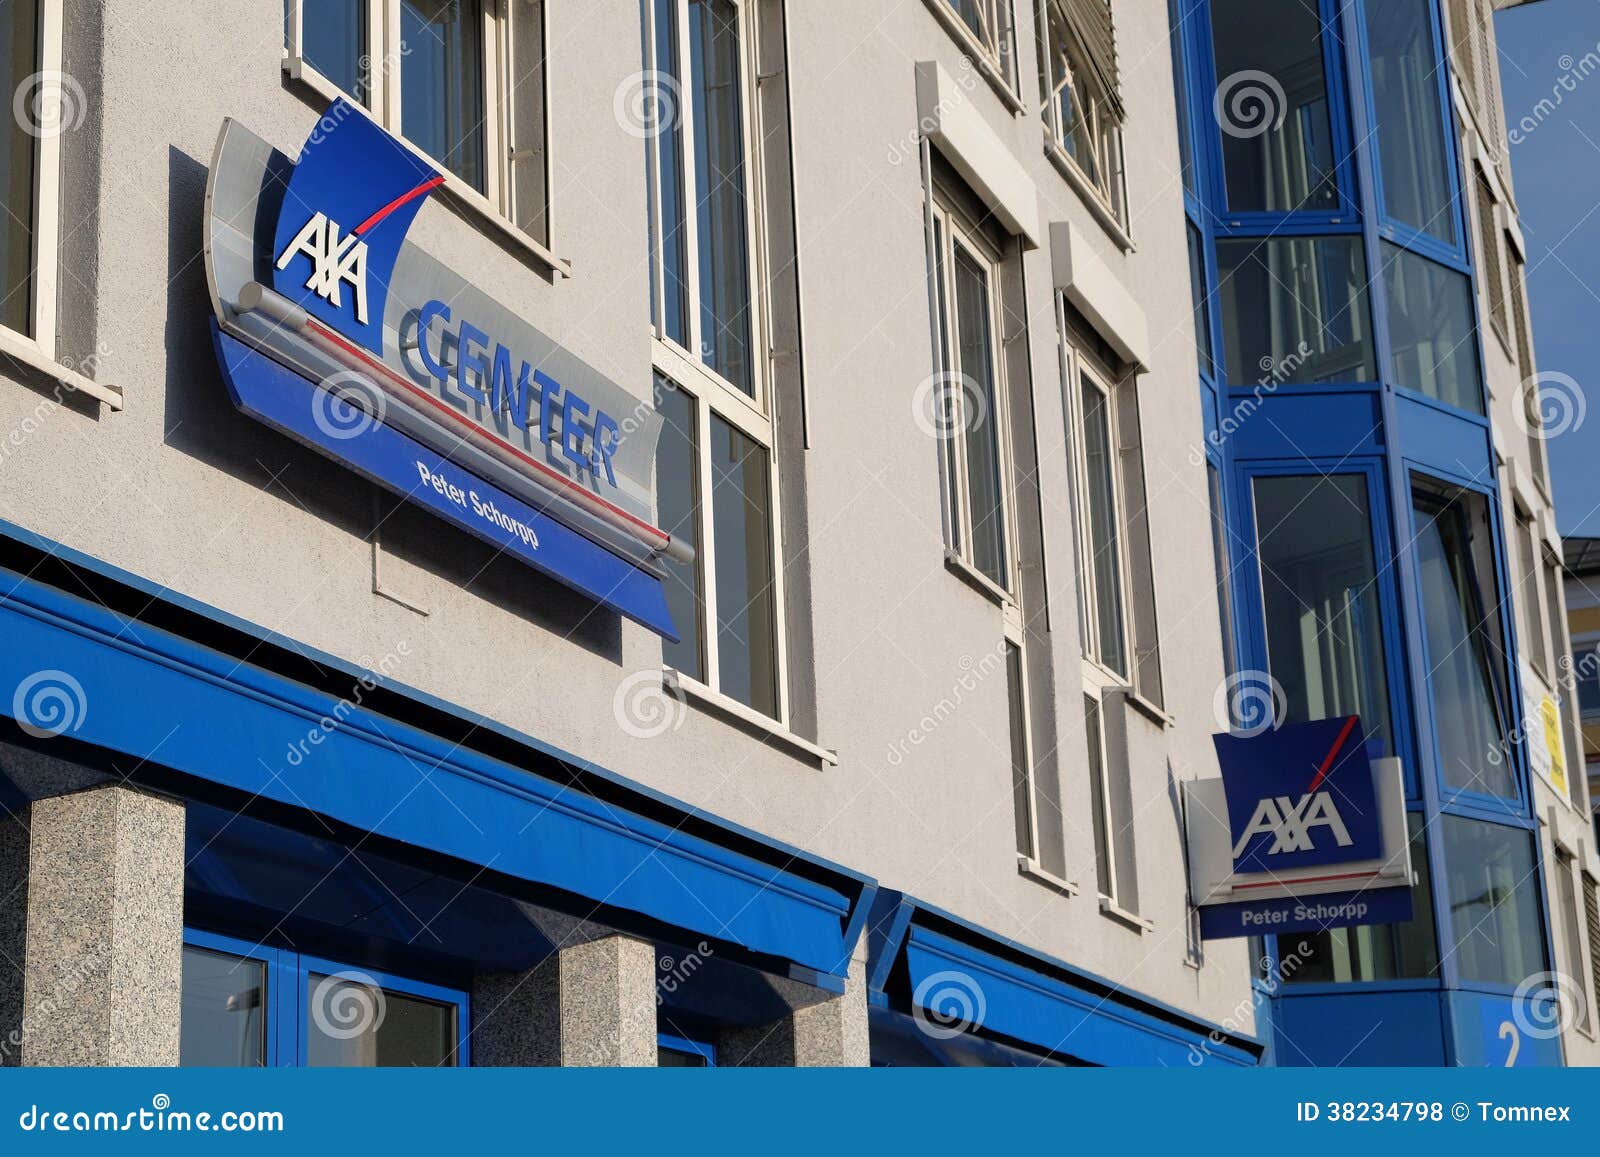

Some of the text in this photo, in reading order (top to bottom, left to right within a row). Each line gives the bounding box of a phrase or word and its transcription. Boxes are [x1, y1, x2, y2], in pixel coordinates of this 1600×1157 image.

[276, 211, 620, 488] AXA CENTER
[416, 460, 539, 551] Peter Schorpp
[1232, 791, 1355, 860] AXA
[1241, 902, 1368, 926] Peter Schorpp
